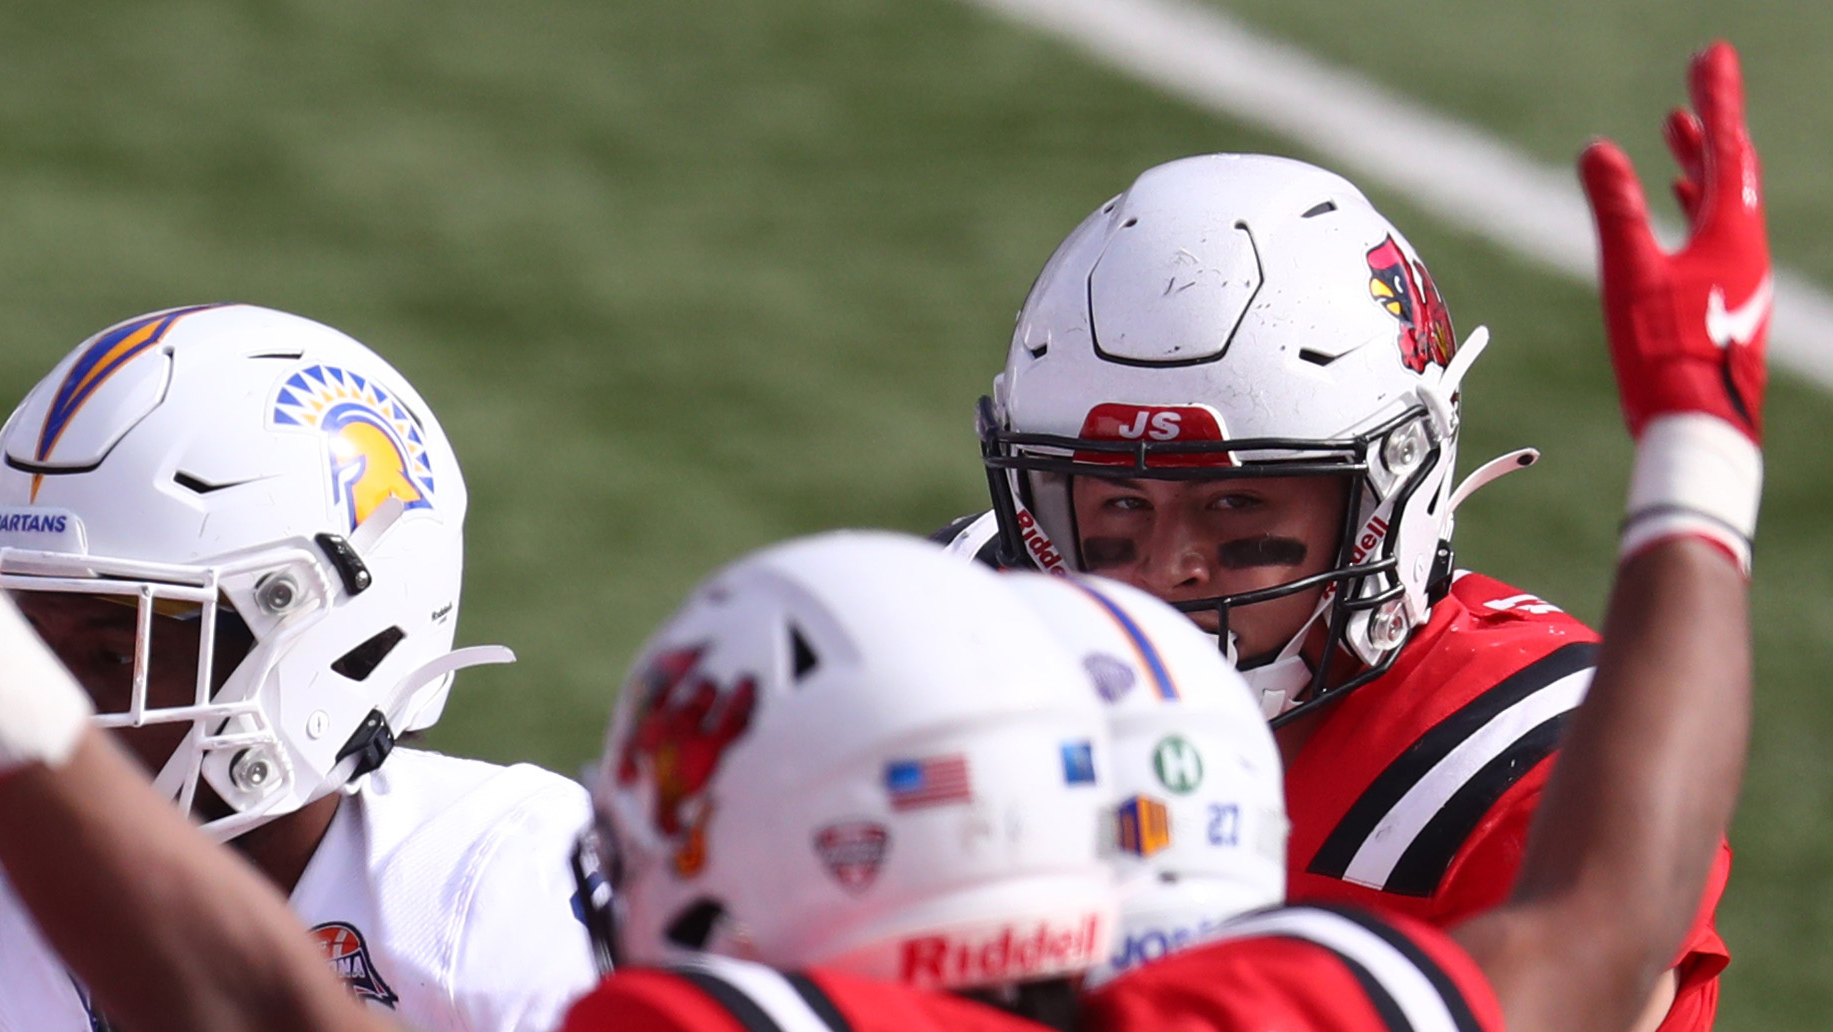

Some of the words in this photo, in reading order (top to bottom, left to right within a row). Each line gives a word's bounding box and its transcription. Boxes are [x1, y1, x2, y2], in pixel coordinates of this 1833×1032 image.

[1118, 411, 1181, 440] JS
[1017, 508, 1067, 579] Ridde
[1208, 803, 1240, 846] 27
[898, 912, 1100, 985] Riddell
